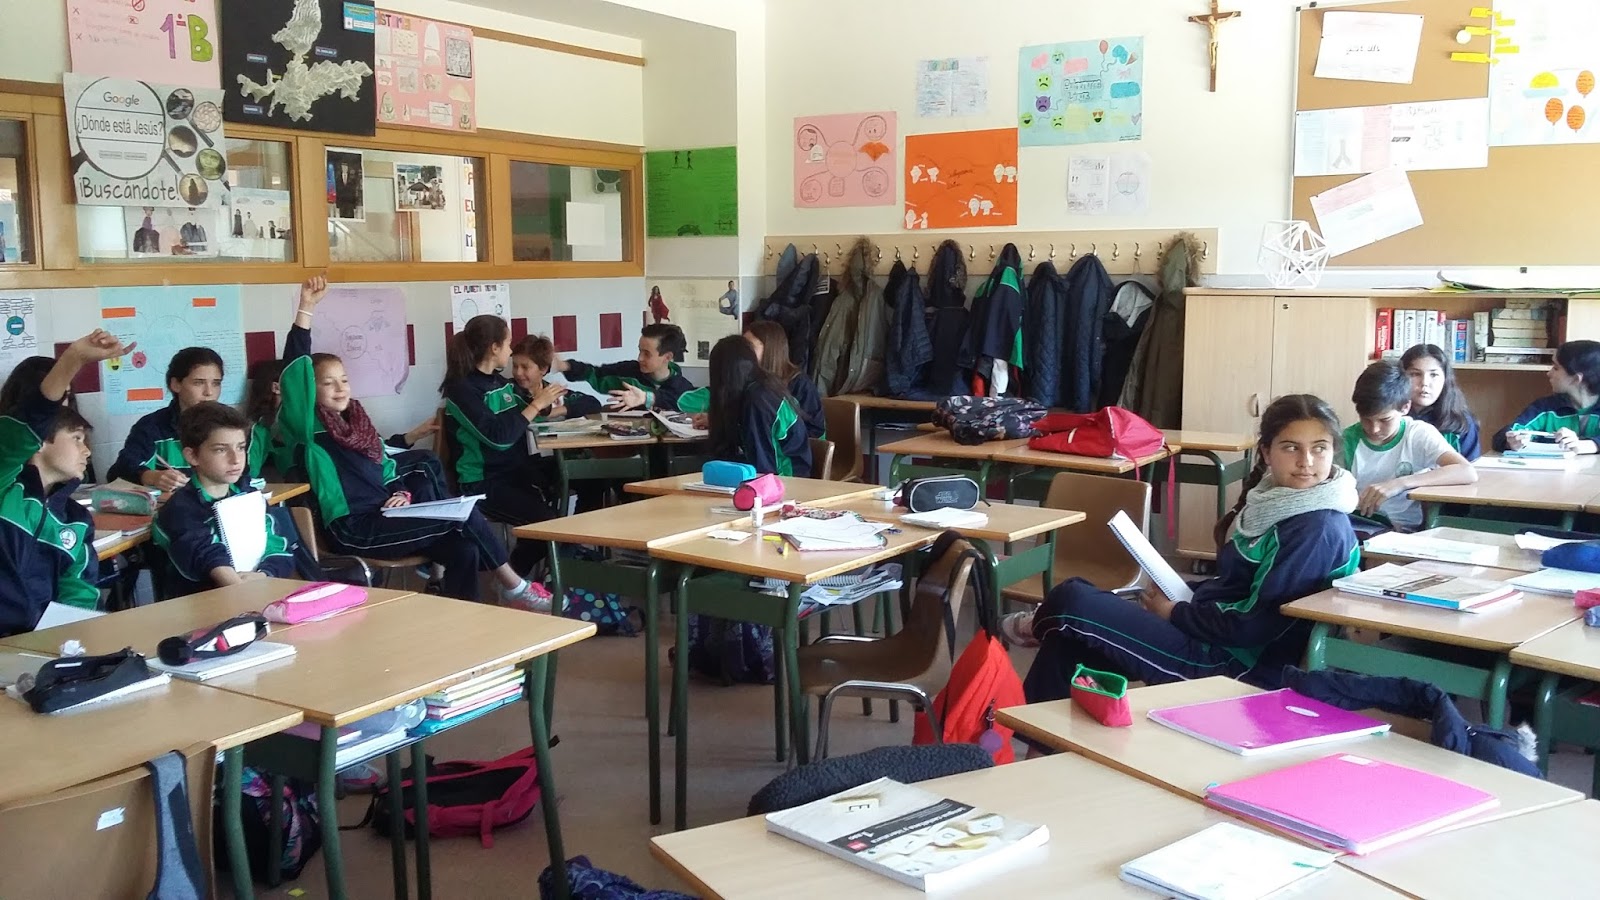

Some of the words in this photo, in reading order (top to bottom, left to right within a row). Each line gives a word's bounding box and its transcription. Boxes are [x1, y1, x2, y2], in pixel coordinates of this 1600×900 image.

[103, 91, 140, 107] Google
[76, 114, 111, 135] ¿Dónde
[113, 116, 131, 134] está
[133, 117, 163, 137] Jesús?
[79, 174, 180, 202] ¡Buscándote!
